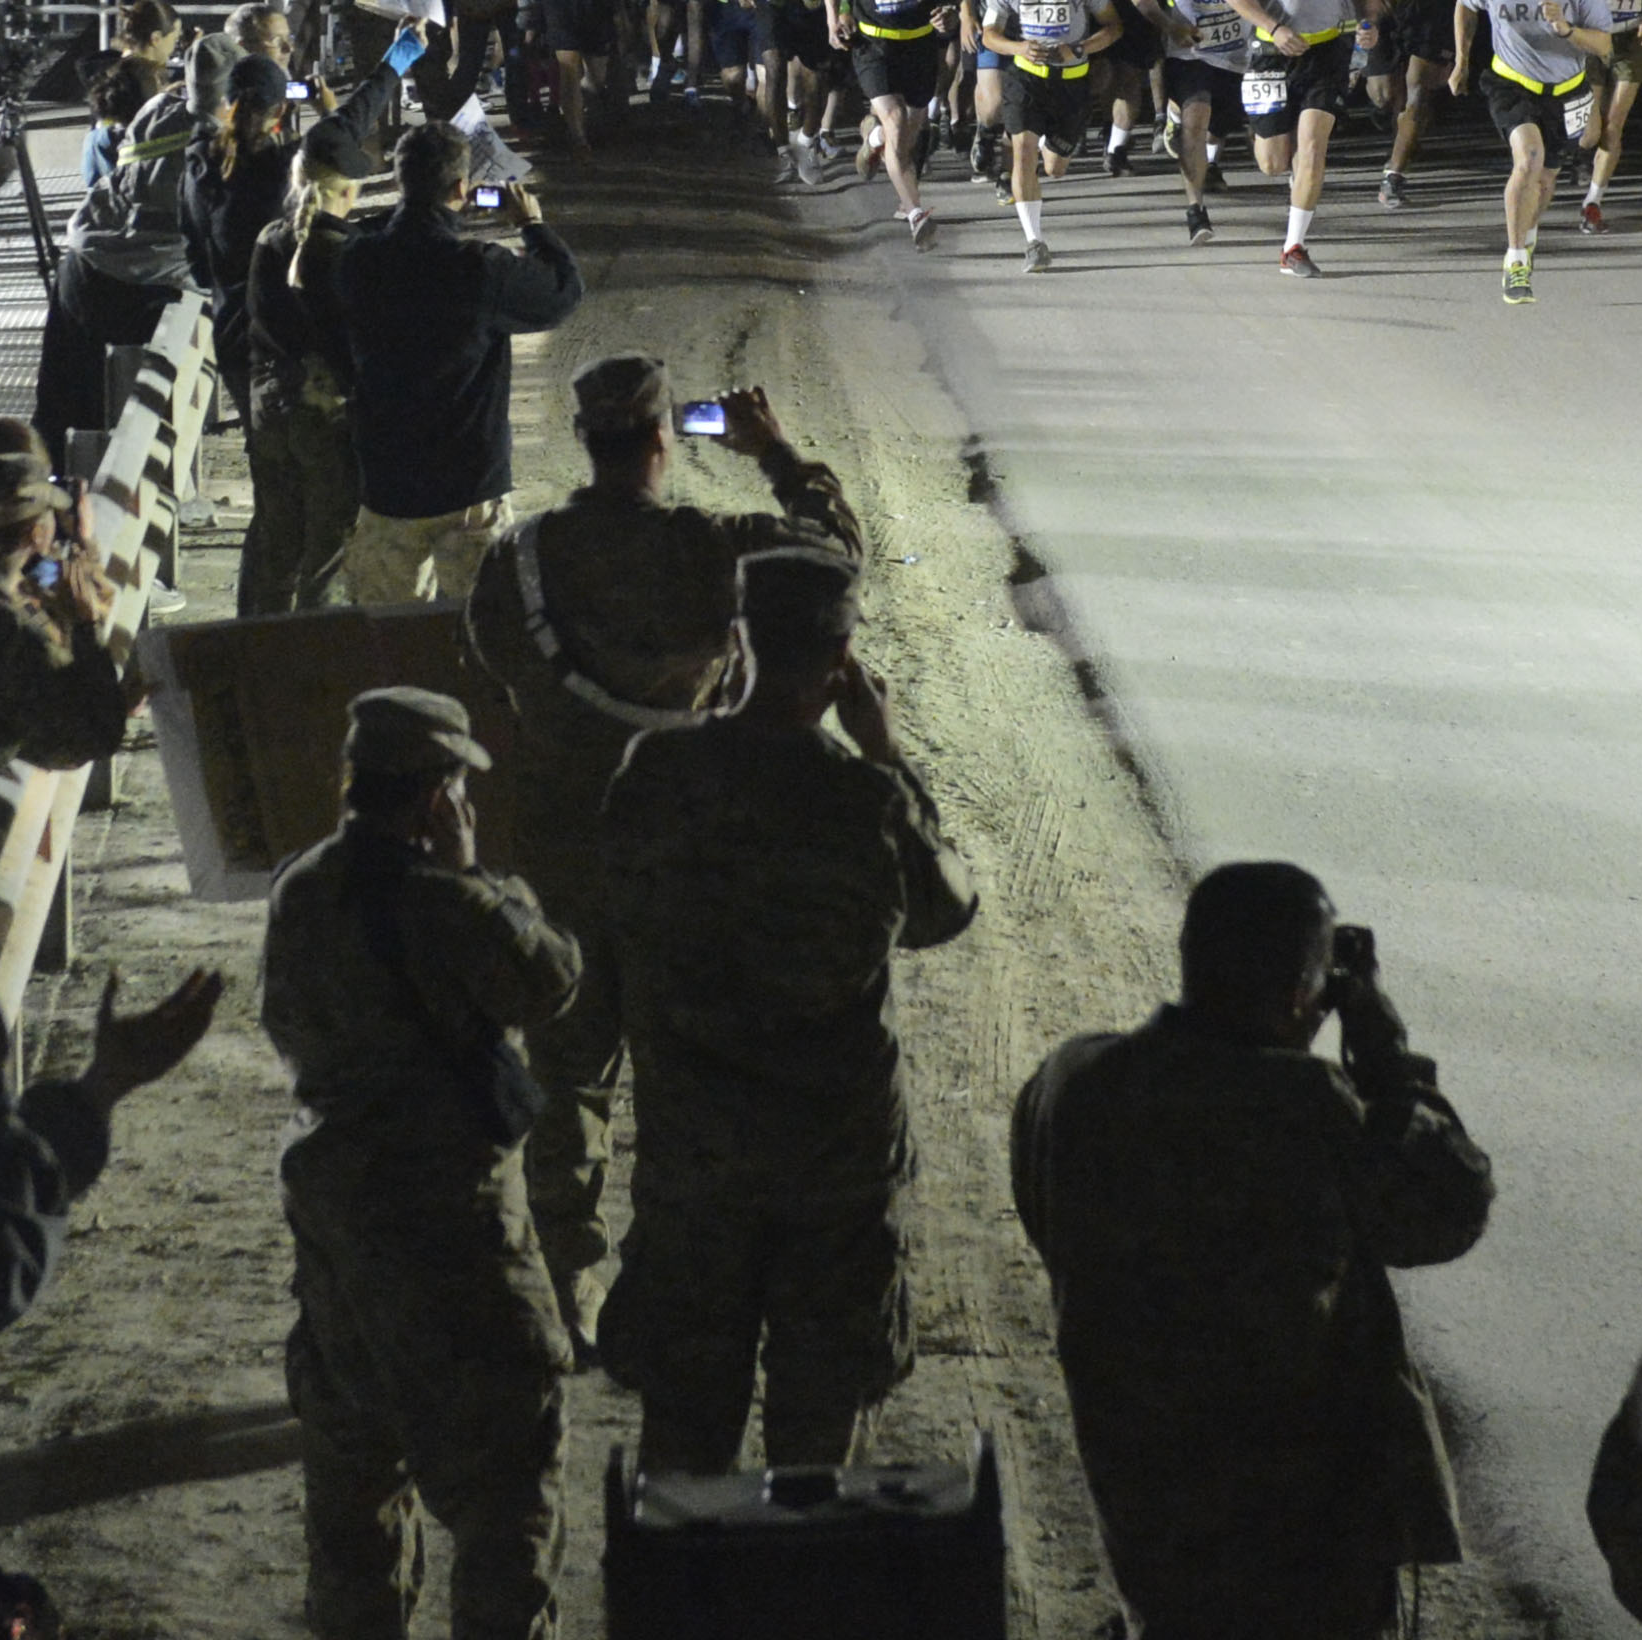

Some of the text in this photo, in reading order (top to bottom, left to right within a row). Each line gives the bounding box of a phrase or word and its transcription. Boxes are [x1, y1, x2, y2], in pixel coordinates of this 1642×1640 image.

[1034, 7, 1067, 24] 128
[1211, 22, 1241, 43] 469
[1251, 83, 1282, 100] 591
